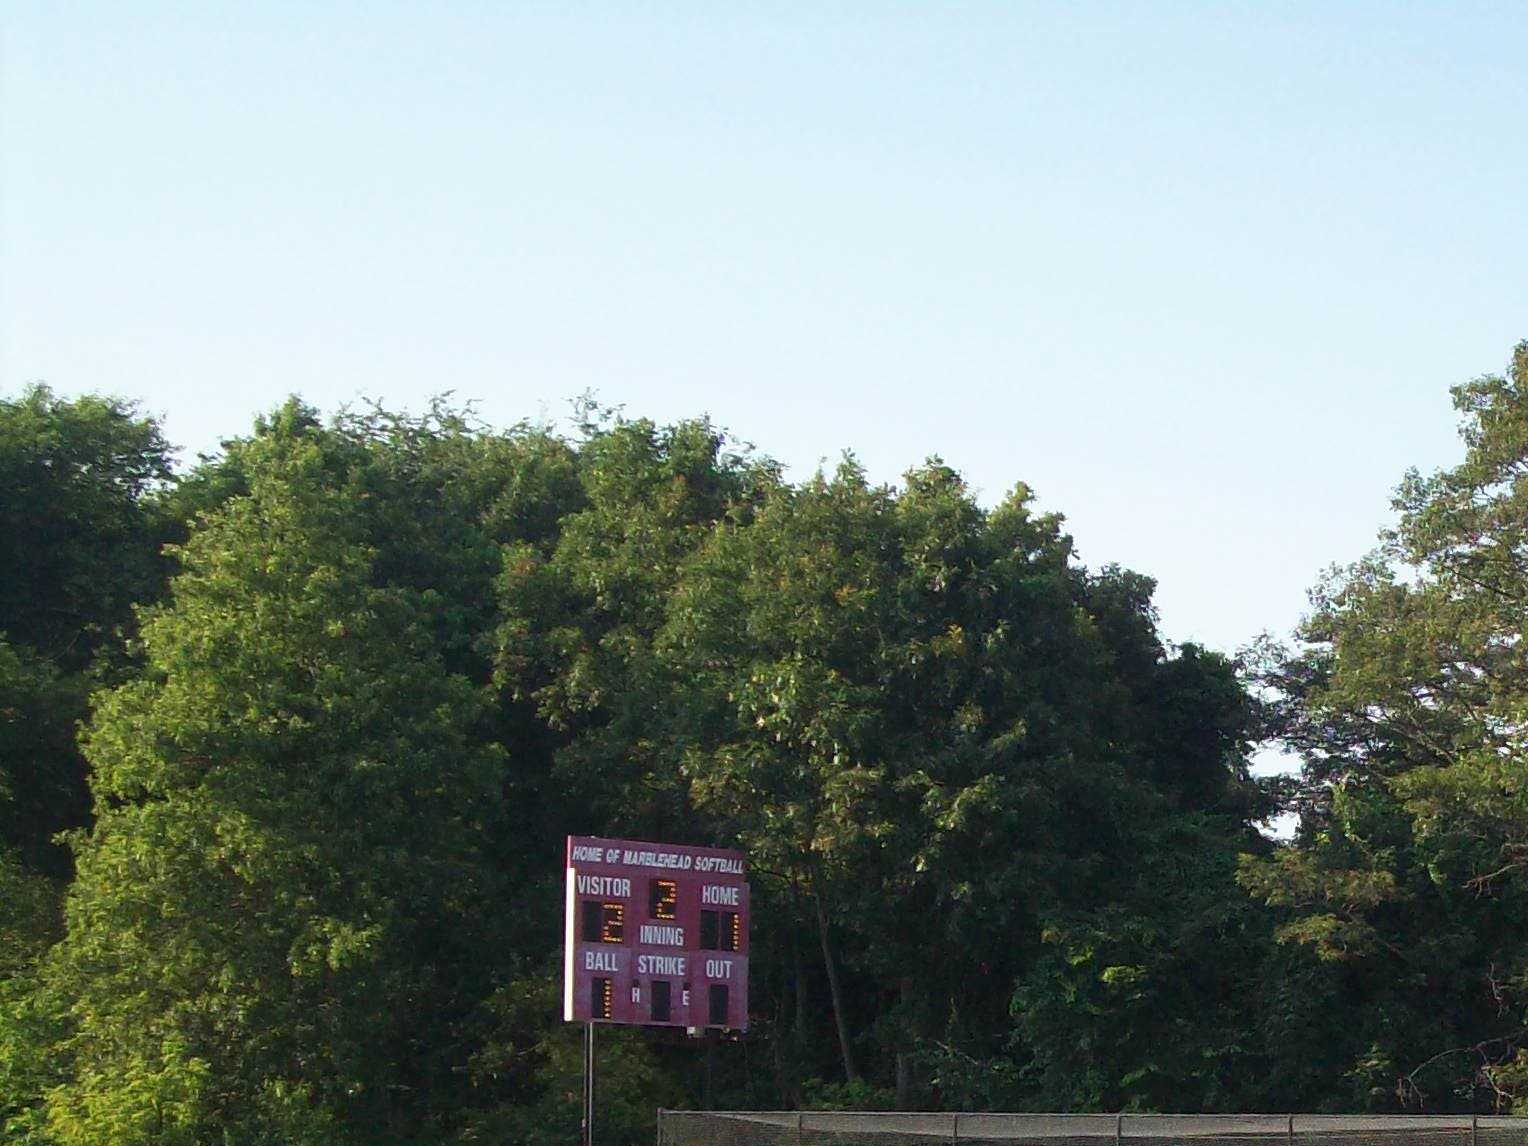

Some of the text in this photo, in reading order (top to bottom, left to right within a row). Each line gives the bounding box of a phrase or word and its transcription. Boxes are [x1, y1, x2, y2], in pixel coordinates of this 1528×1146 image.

[572, 846, 743, 874] HOME OF MARBLEHEAD SOFTBALL
[577, 875, 630, 897] VISITOR
[702, 886, 738, 906] HOME
[657, 881, 676, 919] 2
[603, 904, 623, 941] 2
[640, 926, 684, 946] INNING
[586, 952, 618, 972] BALL
[638, 955, 685, 975] STRIKE
[706, 960, 732, 978] OUT
[632, 987, 640, 1003] H
[682, 990, 690, 1006] E
